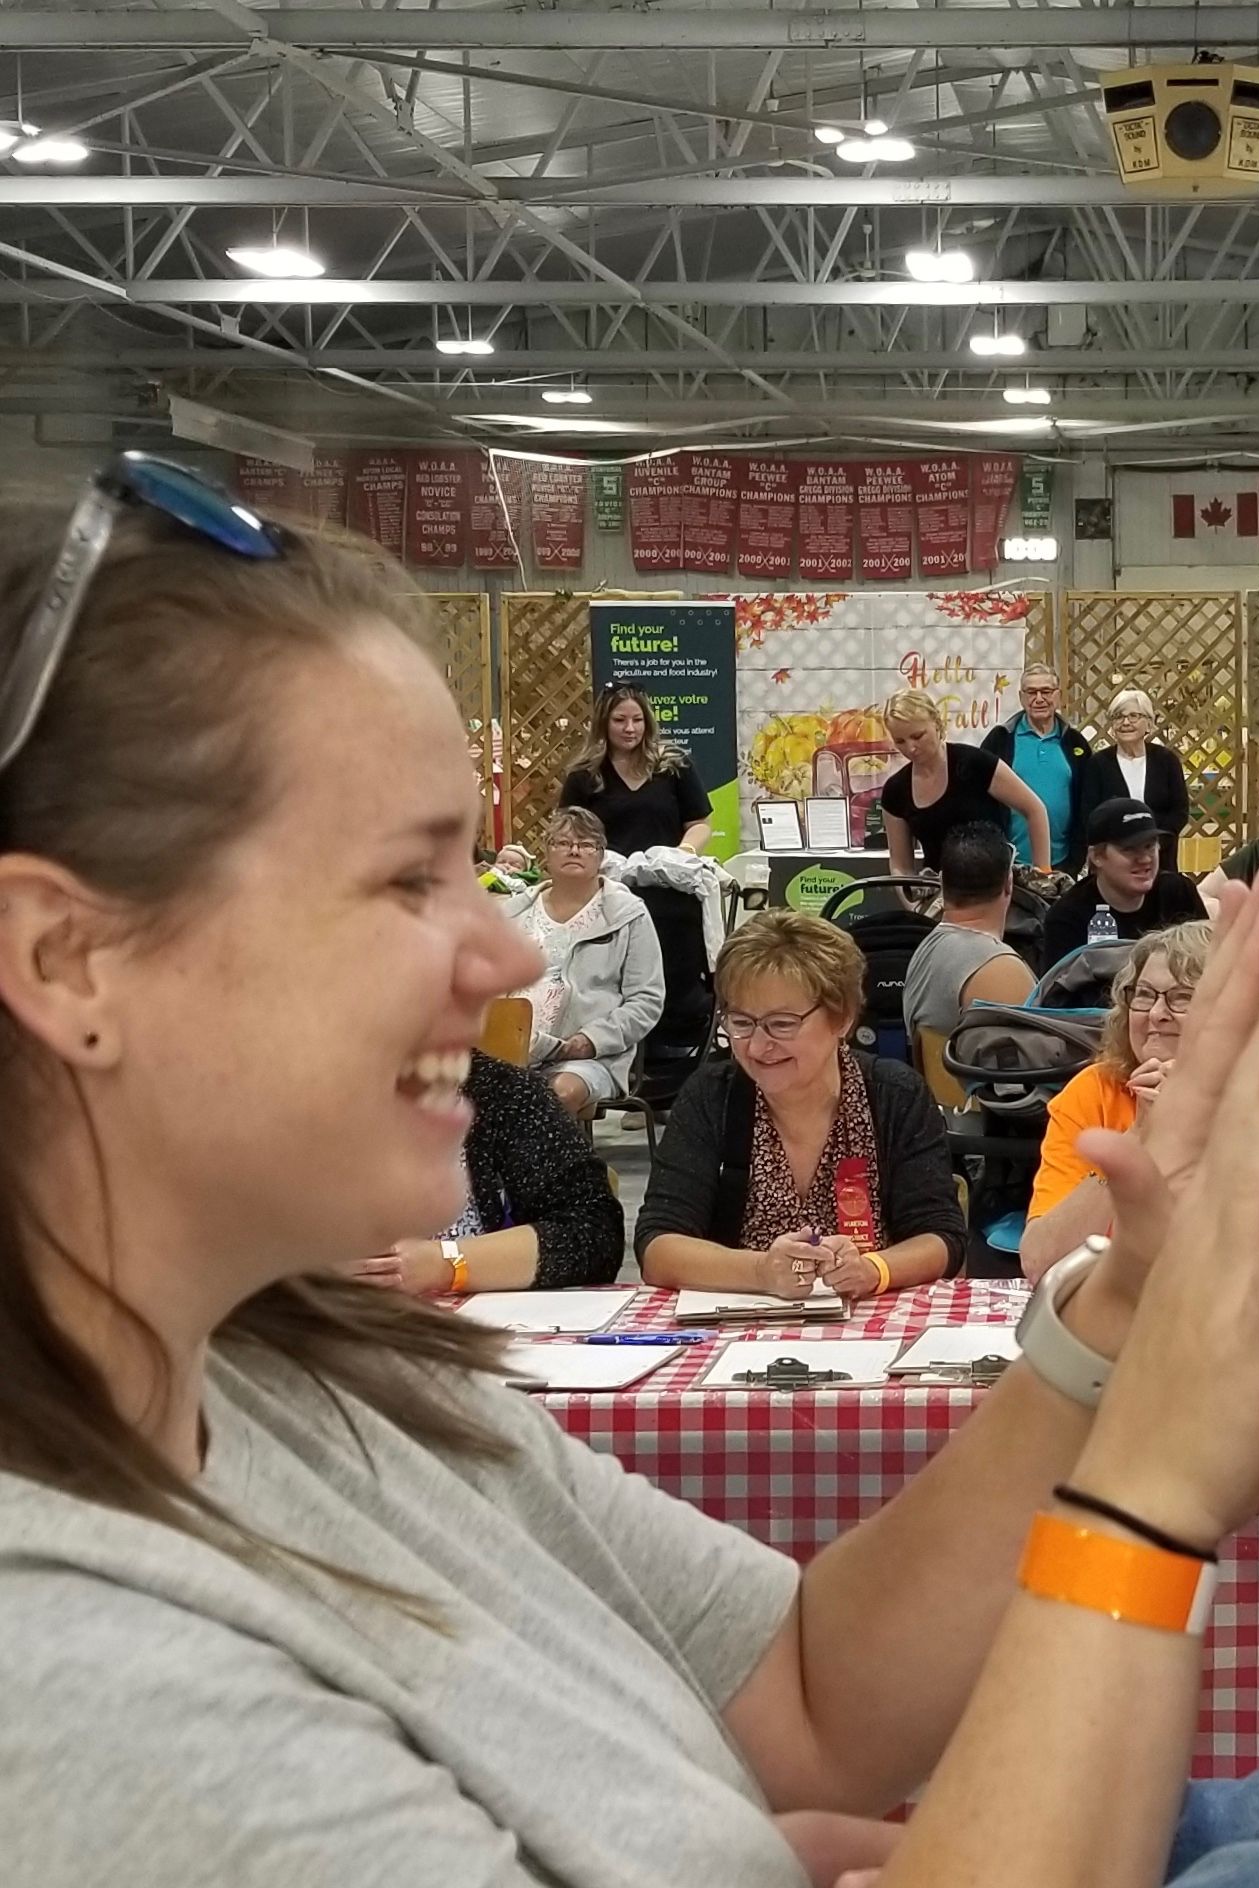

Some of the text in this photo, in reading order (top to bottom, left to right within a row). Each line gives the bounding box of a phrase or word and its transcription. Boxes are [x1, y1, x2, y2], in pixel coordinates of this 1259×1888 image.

[634, 467, 679, 476] JUVENILE
[691, 467, 731, 479] BANTAM
[416, 474, 461, 483] RED LOBSTER
[694, 477, 727, 487] GROUP
[748, 472, 787, 483] PEEWEE
[806, 476, 846, 485] BANTAM
[866, 476, 903, 485] PEEWEE
[929, 472, 956, 482] ATOM
[303, 478, 344, 487] CHAMPS
[363, 481, 403, 491] CHAMPS
[421, 487, 456, 497] NOVICE
[683, 485, 738, 499] CHAMPIONS
[824, 485, 854, 494] DIVISION
[882, 484, 912, 494] DIVISION
[741, 491, 796, 503] CHAMPIONS
[799, 495, 854, 504] CHAMPIONS
[858, 493, 912, 504] CHAMPIONS
[915, 489, 968, 503] CHAMPIONS
[416, 511, 460, 520] CONSOLATION
[422, 525, 456, 535] CHAMPS
[633, 549, 657, 558] 2000
[709, 552, 730, 562] 2001
[738, 554, 791, 565] 2000 2001
[800, 559, 852, 568] 2001 2002
[863, 559, 885, 568] 2001
[923, 555, 945, 565] 2001
[610, 624, 664, 636] Find your
[611, 636, 679, 652] future!
[646, 659, 658, 667] job
[695, 658, 707, 666] the
[613, 669, 652, 678] agriculture
[687, 669, 718, 678] industry!
[900, 651, 976, 688] Hello
[650, 695, 708, 704] uvez votre
